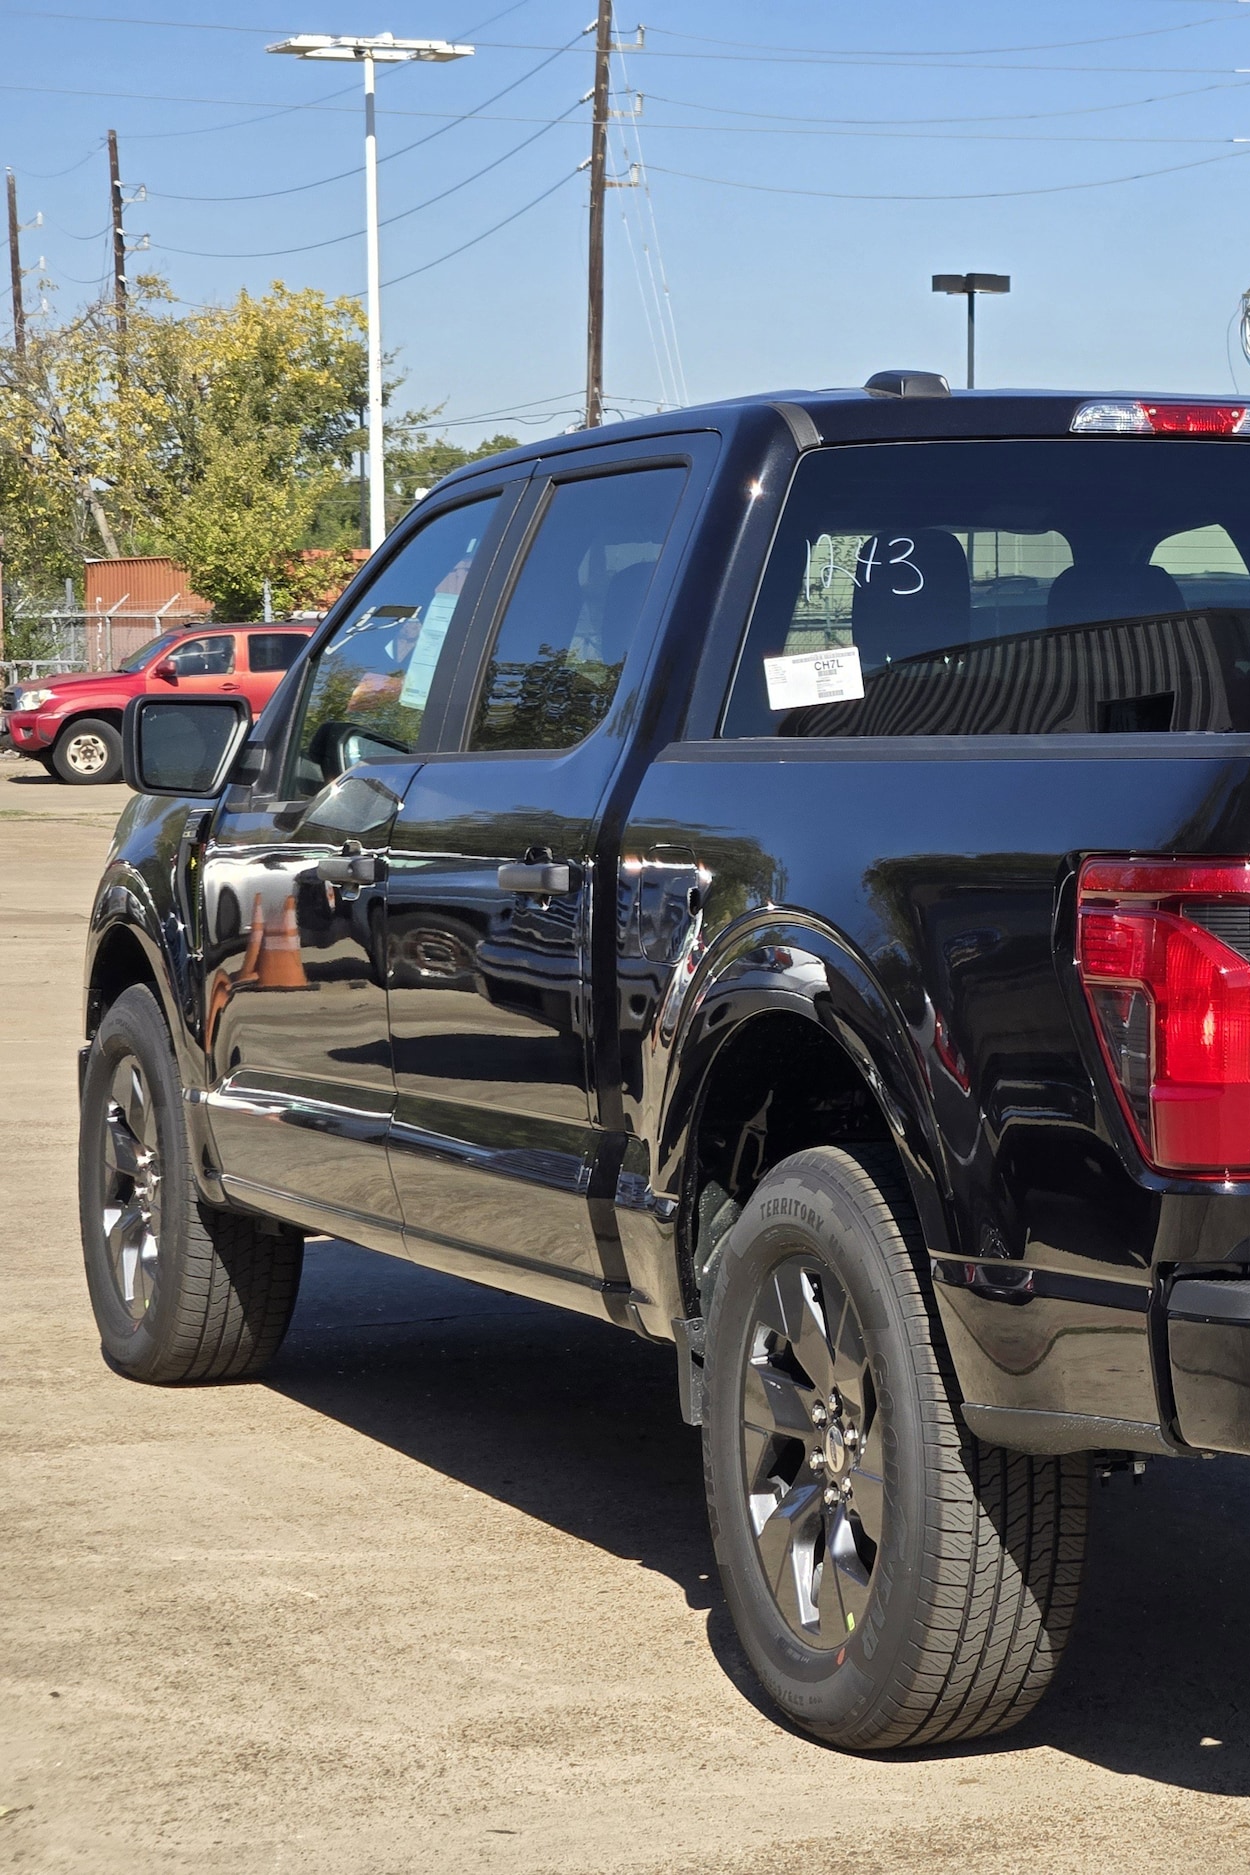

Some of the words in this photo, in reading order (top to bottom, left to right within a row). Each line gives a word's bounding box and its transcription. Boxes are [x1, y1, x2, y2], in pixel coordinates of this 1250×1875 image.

[805, 533, 924, 602] 1243
[814, 660, 844, 671] CH7L
[759, 1197, 824, 1233] TERRITORY
